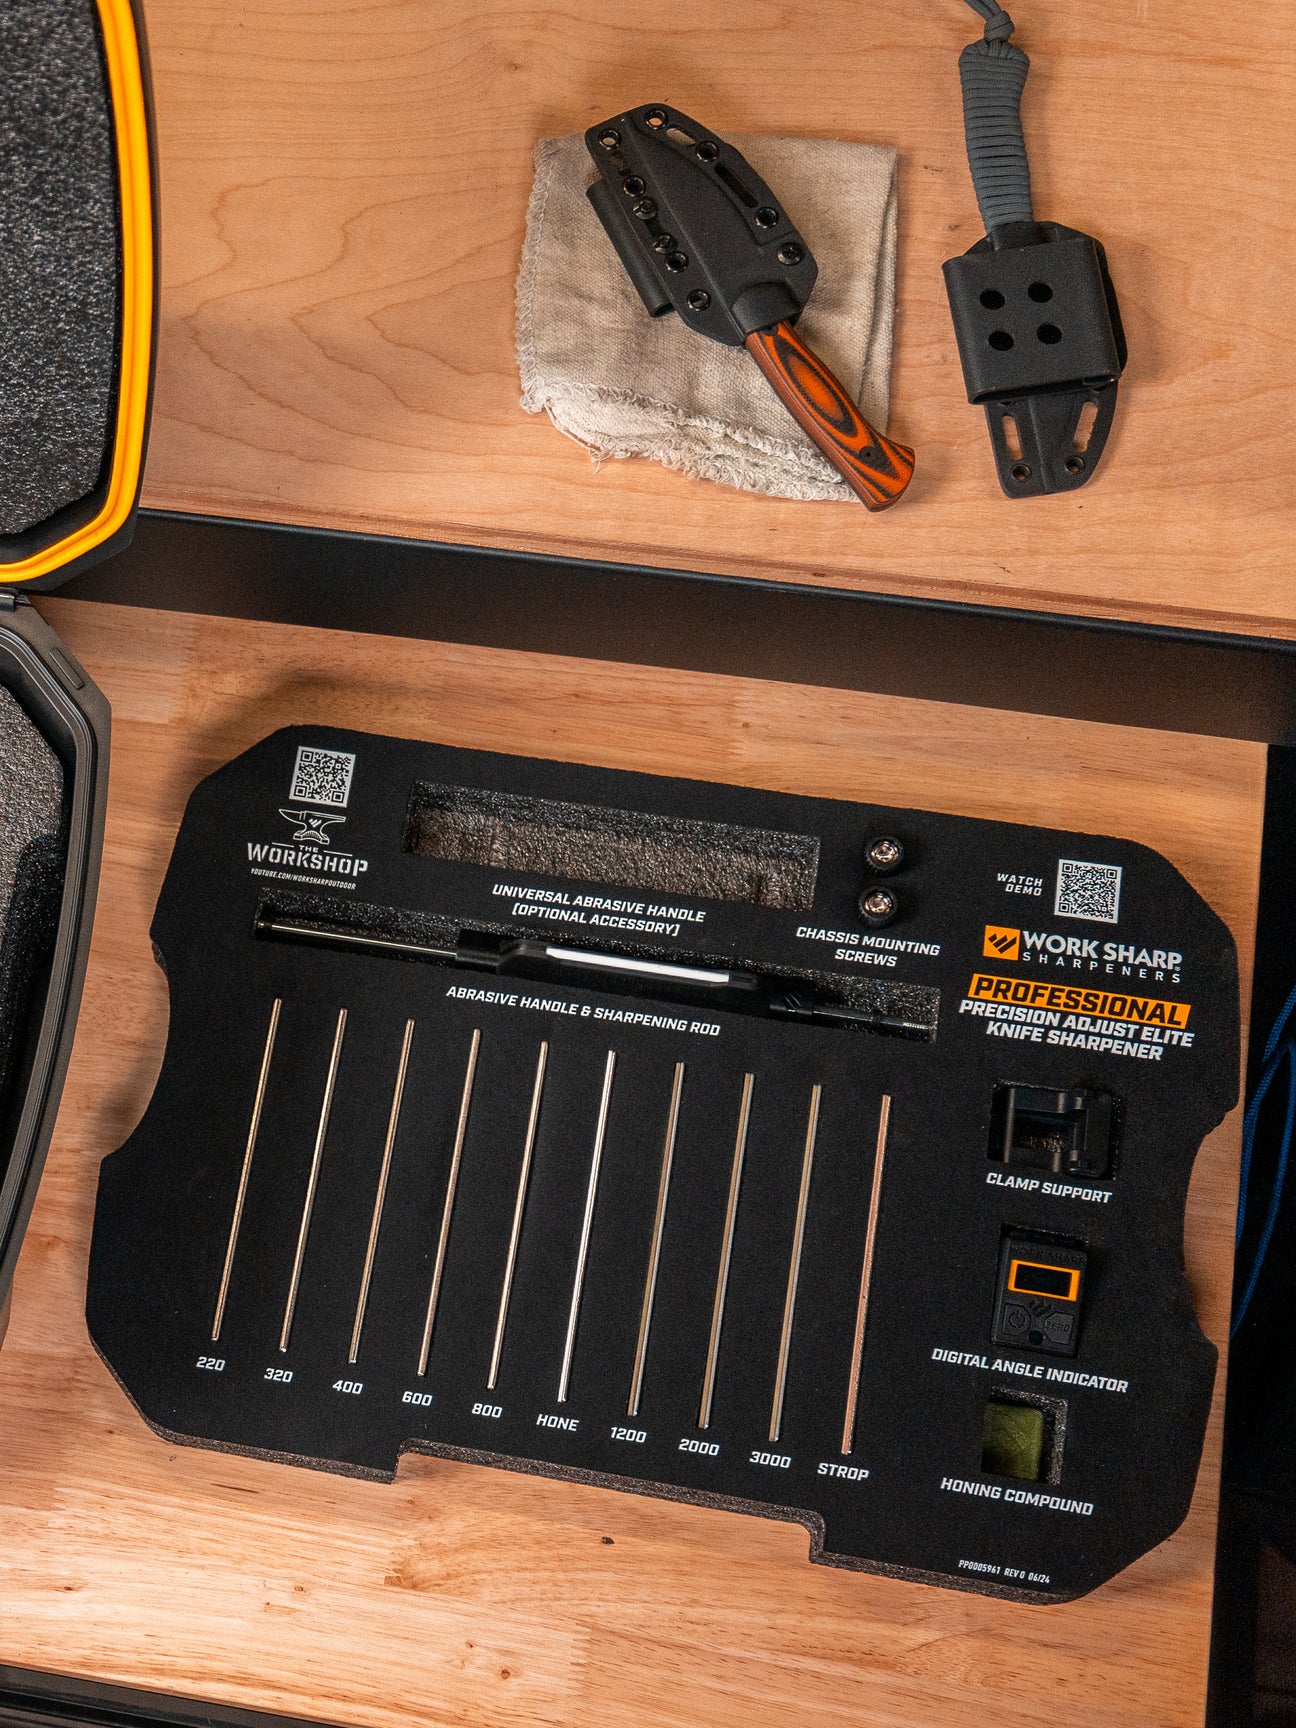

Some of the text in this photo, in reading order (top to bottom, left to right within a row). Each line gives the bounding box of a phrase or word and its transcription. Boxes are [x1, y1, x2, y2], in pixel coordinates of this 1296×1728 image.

[299, 845, 319, 853] THE
[247, 842, 369, 877] WORKSHOP
[250, 867, 357, 890] YOUTUBE.COM/WORKSHARPOUTDOOR
[997, 873, 1043, 887] WATCH
[1005, 883, 1043, 896] DEMO
[492, 884, 706, 923] UNIVERSAL ABRASIVE HANDLE
[796, 926, 941, 956] CHASSIS MOUNTING
[1022, 930, 1100, 959] WORK
[834, 948, 898, 968] SCREWS
[1022, 951, 1181, 983] SHARPENERS
[446, 986, 721, 1036] ABRASIVE HANDLE & SHARPENING ROD
[973, 976, 1183, 1026] PROFESSIONAL
[958, 1000, 1196, 1047] PRECISION ADJUST ELITE
[985, 1020, 1164, 1061] KNIFE SHARPENER
[986, 1172, 1113, 1204] CLAMP SUPPORT
[1046, 1321, 1070, 1333] ZERO
[196, 1356, 226, 1372] 220
[931, 1348, 1129, 1393] DIGITAL ANGLE INDICATOR
[264, 1367, 293, 1383] 320
[332, 1379, 363, 1395] 400
[402, 1391, 433, 1407] 600
[471, 1403, 503, 1419] 800
[535, 1413, 580, 1432] HONE
[610, 1426, 647, 1444] 1200
[678, 1438, 720, 1456] 2000
[749, 1451, 792, 1469] 3000
[817, 1462, 870, 1482] STROP
[940, 1477, 1094, 1516] HONING COMPOUND
[958, 1559, 1001, 1575] PP0005961
[1027, 1572, 1051, 1584] 06/24
